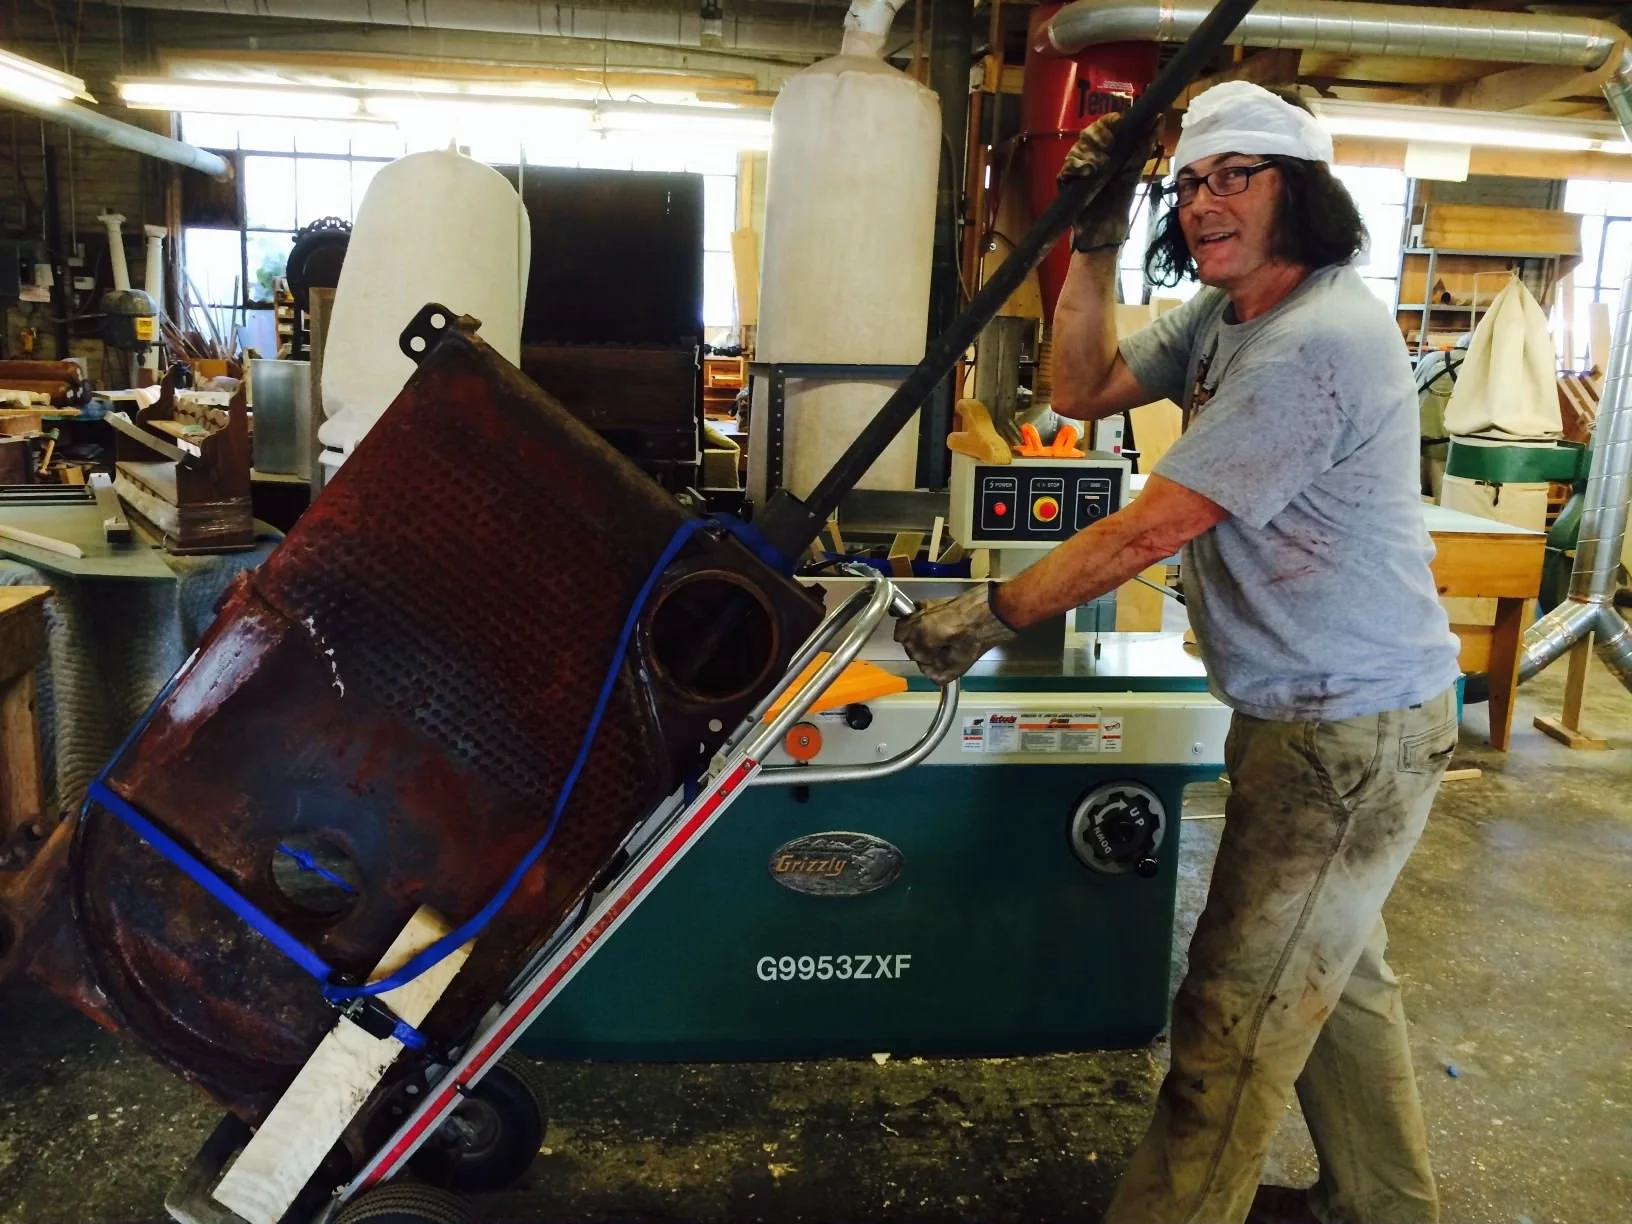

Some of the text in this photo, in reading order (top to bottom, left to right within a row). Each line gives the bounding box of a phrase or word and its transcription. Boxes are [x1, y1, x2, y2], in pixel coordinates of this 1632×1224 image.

[1129, 807, 1145, 827] UP
[1094, 826, 1112, 854] DOWN
[775, 854, 847, 876] Grizzly
[756, 955, 912, 981] G9953ZXF
